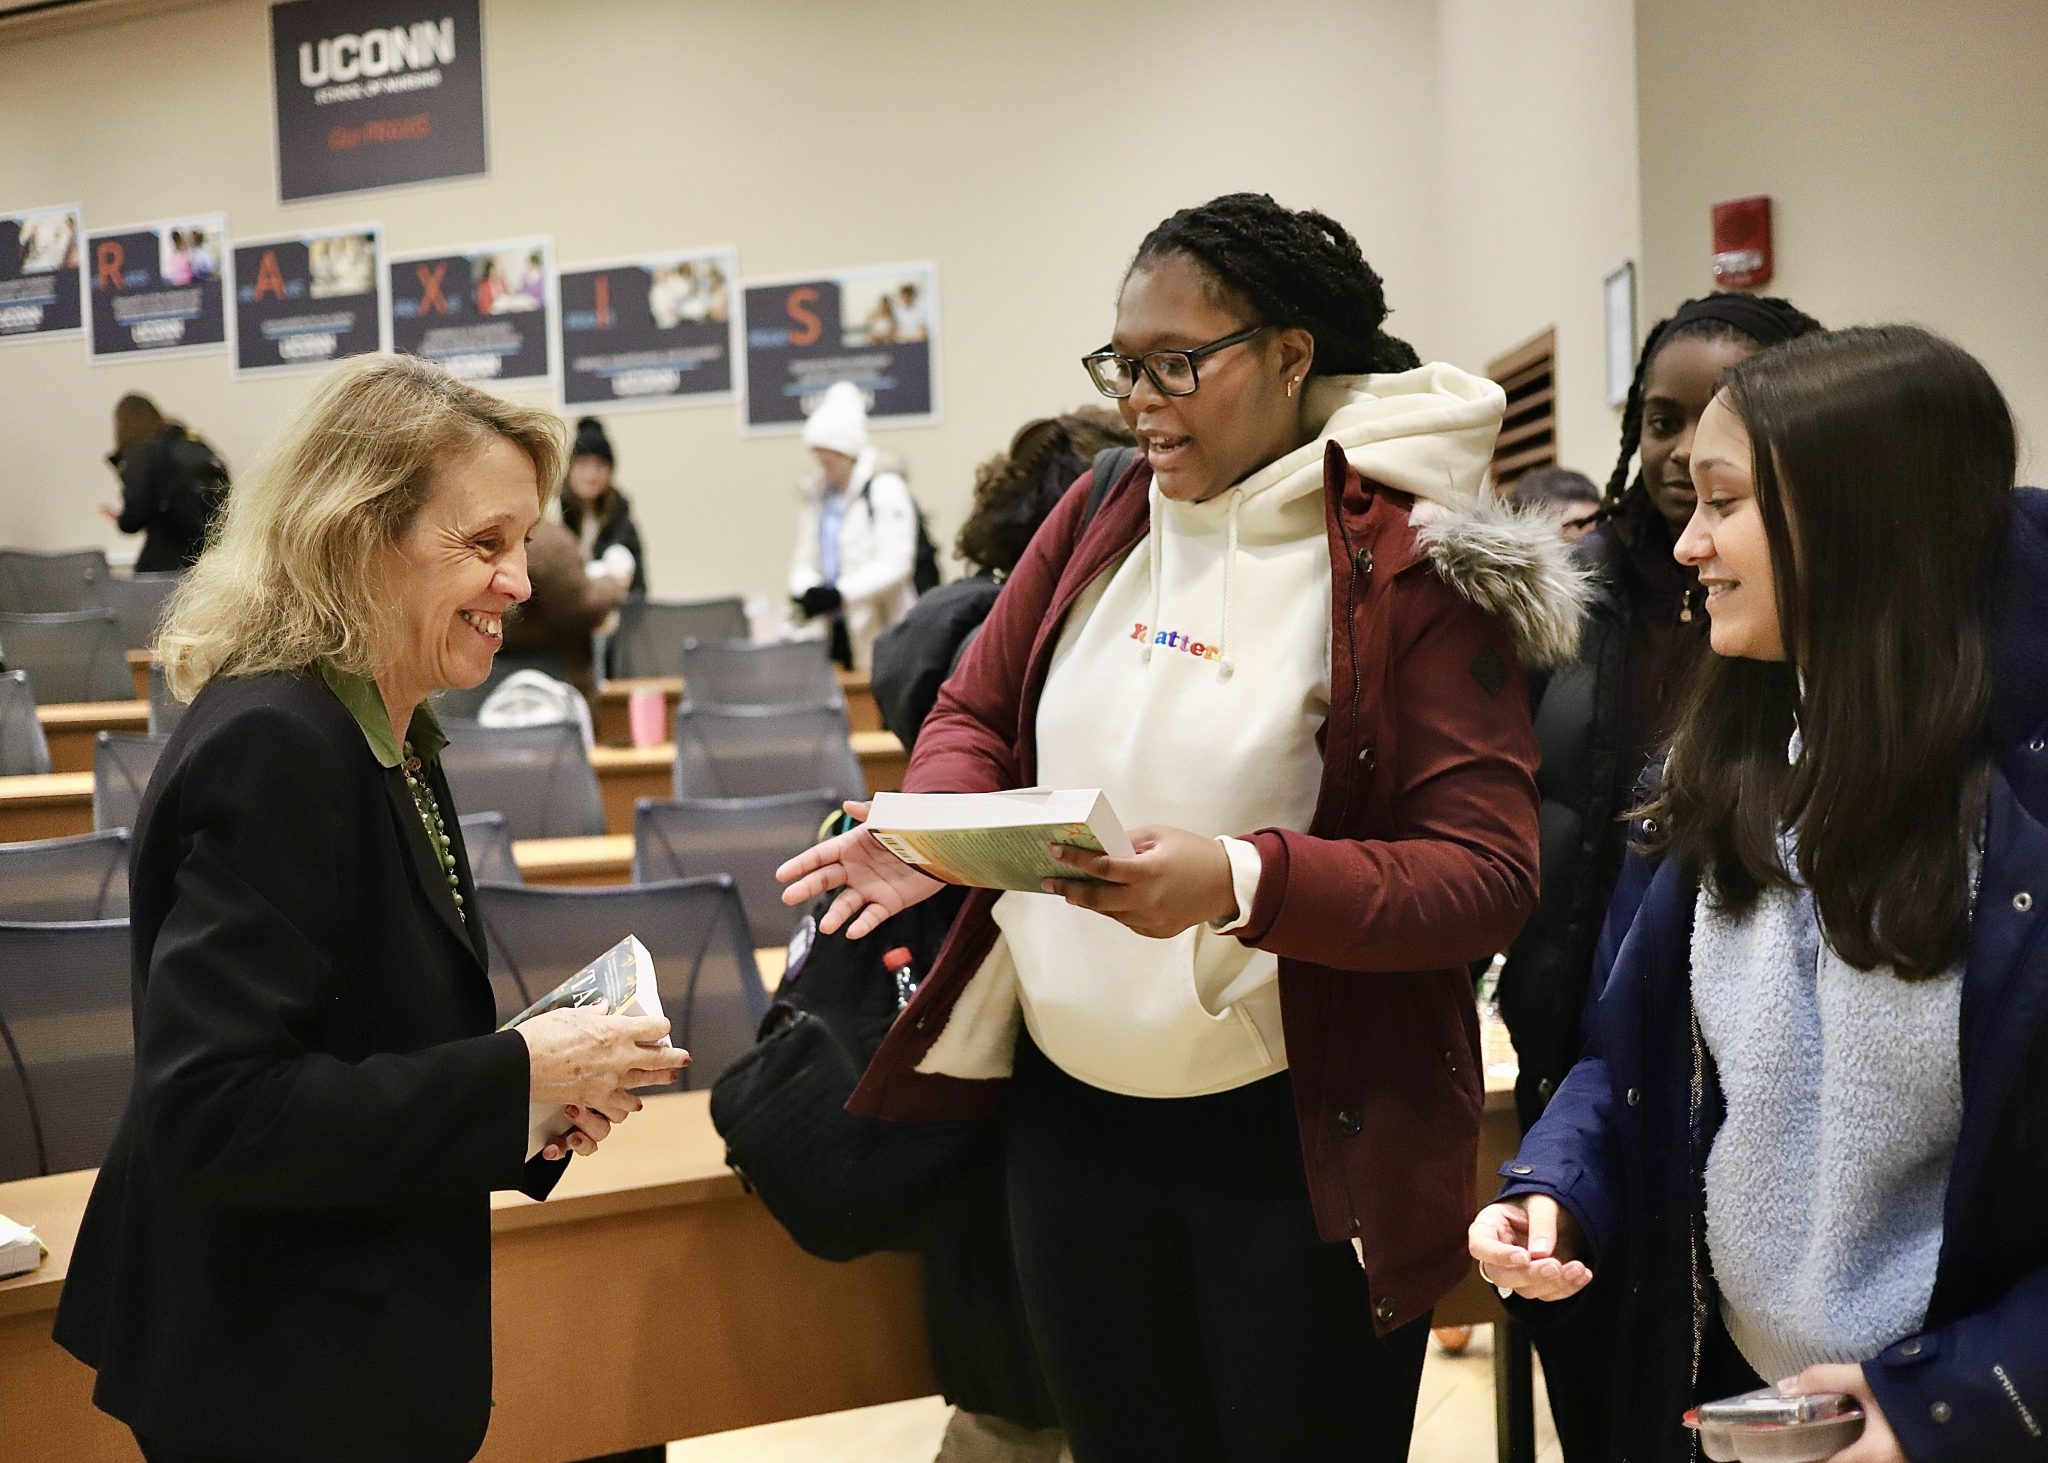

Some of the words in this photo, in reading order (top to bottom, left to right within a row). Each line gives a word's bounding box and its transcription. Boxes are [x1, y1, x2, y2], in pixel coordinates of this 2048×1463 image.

[299, 16, 456, 87] UCONN
[97, 240, 125, 290] R
[255, 250, 287, 302] A
[416, 262, 449, 317] X
[595, 275, 611, 330] I
[786, 286, 823, 346] S
